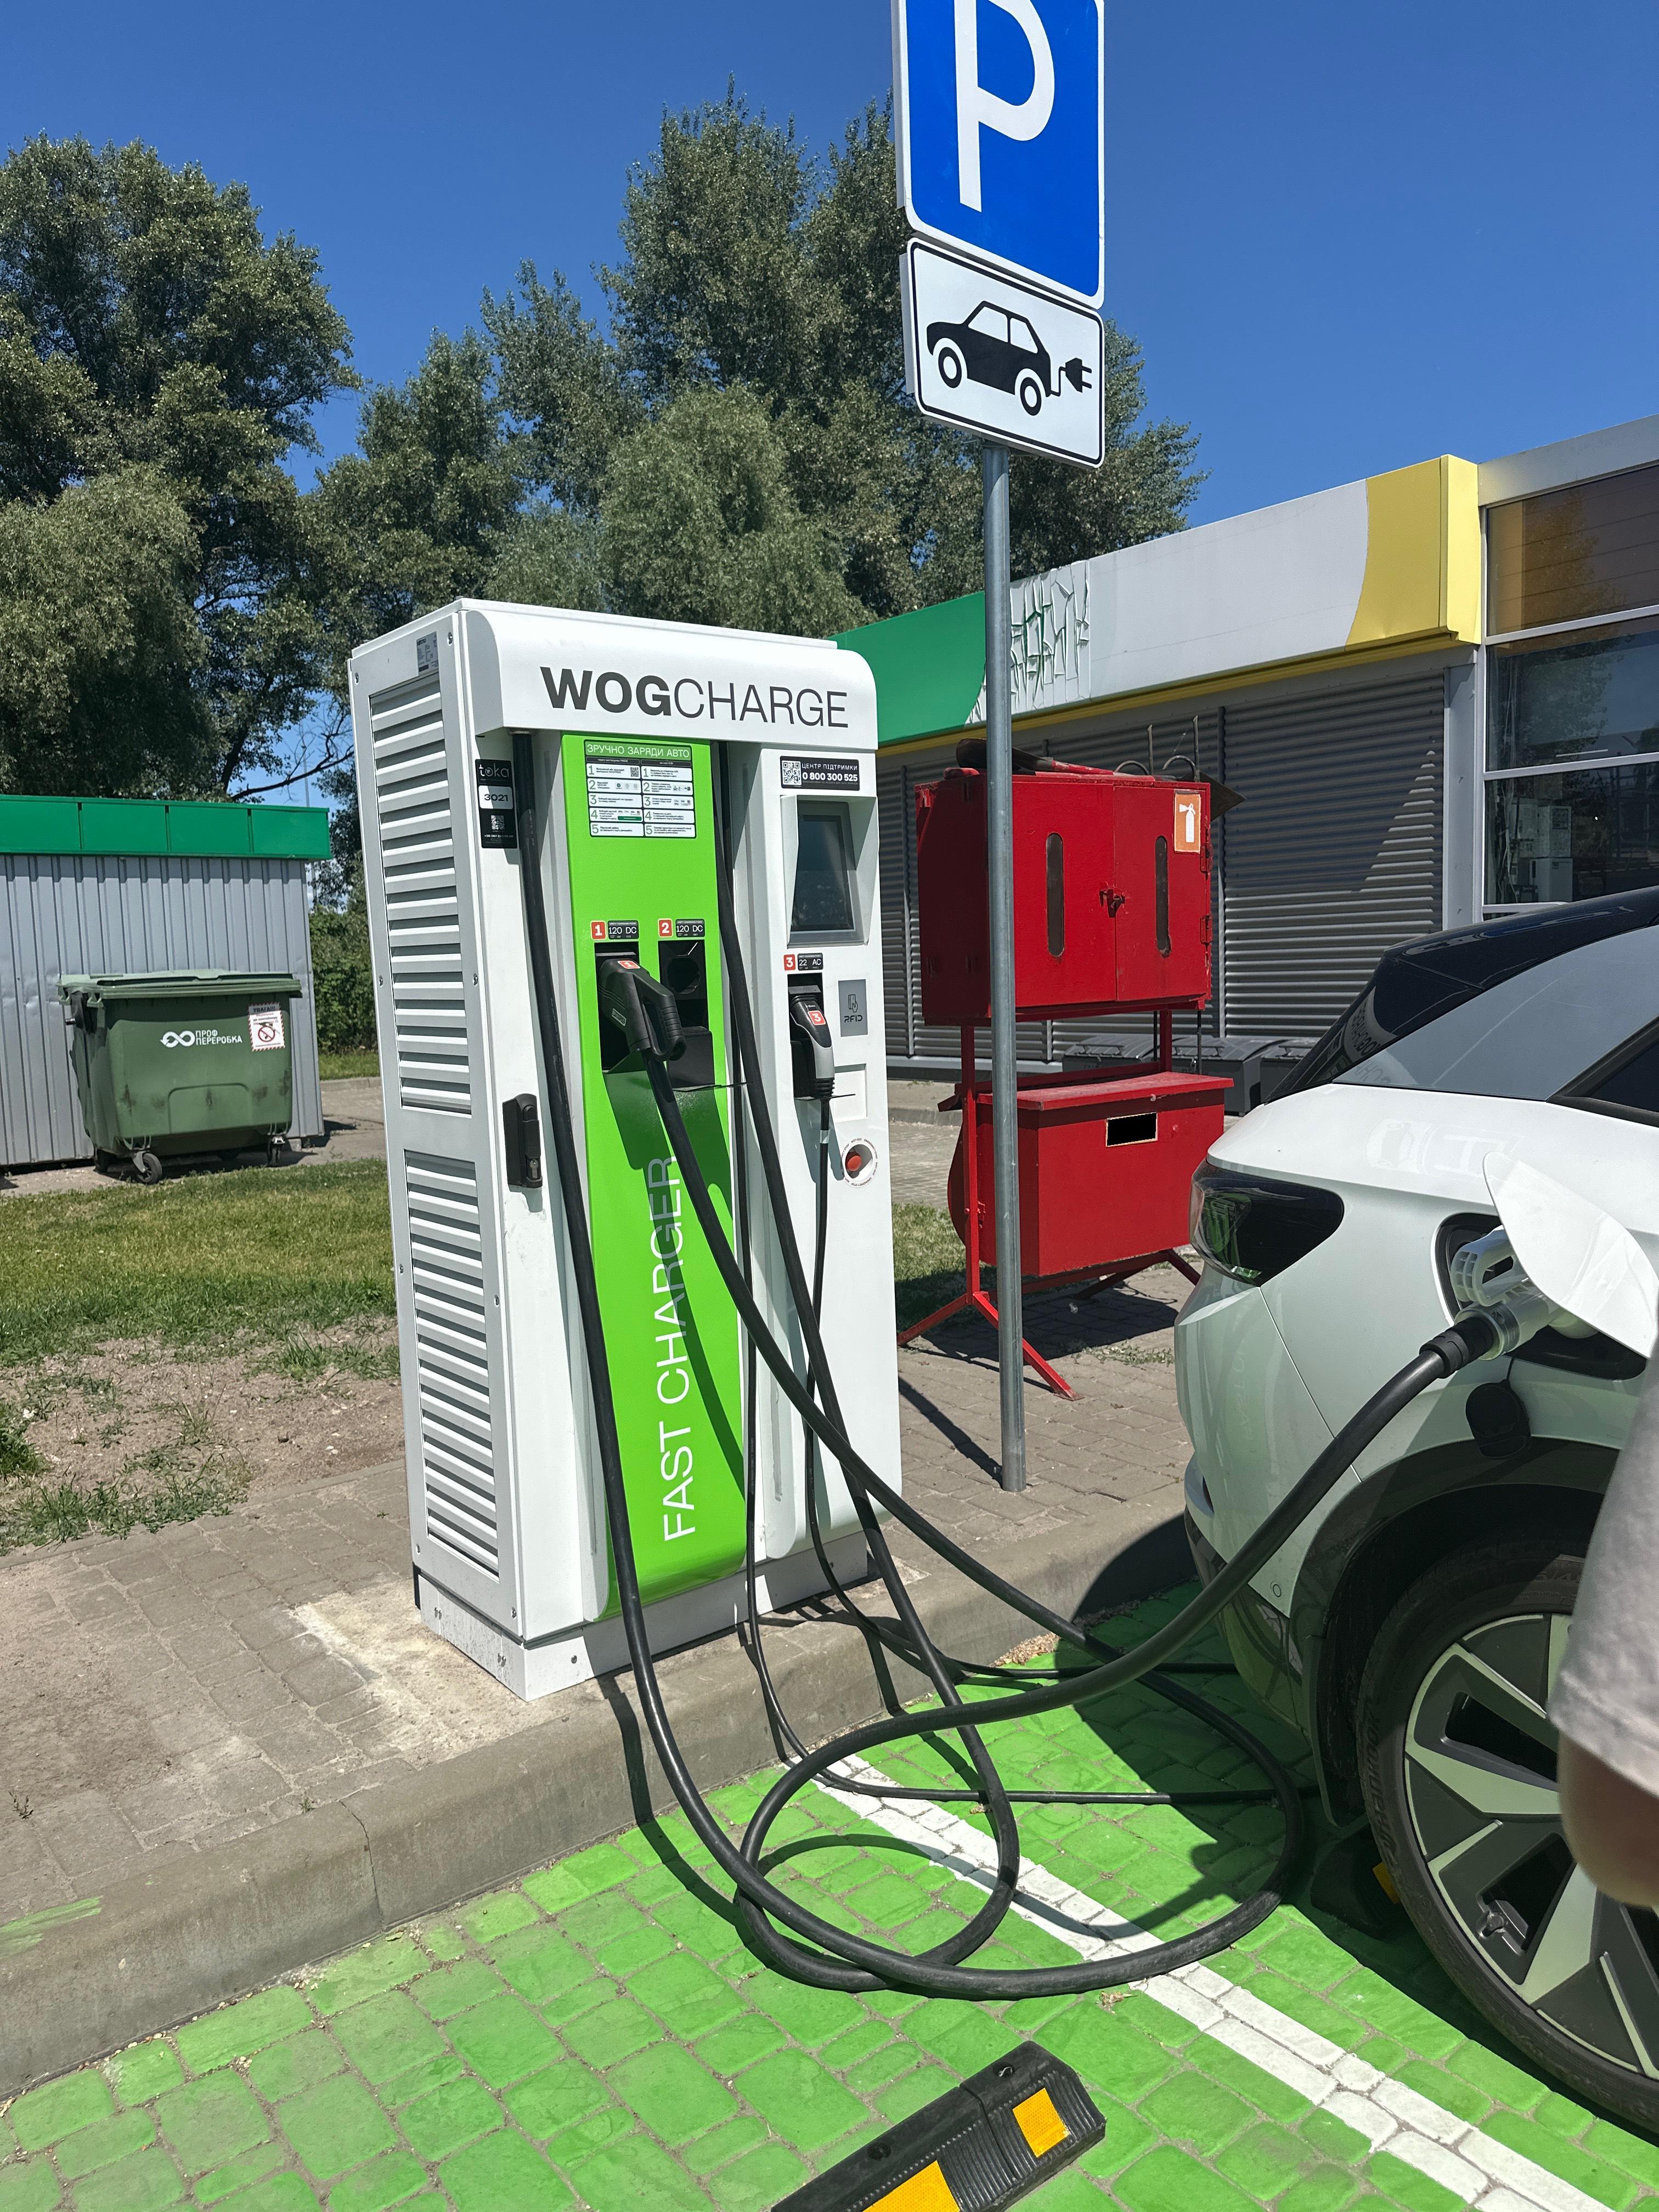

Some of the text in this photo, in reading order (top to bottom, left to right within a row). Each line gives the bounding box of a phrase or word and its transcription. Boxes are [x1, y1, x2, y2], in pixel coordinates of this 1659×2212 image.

[954, 0, 1055, 213] P
[539, 665, 849, 729] WOGCHARGE
[587, 744, 690, 758] ЗРУЧНО ЗАРЯДИ АВТО
[478, 763, 510, 777] toka
[844, 774, 858, 782] 525
[595, 924, 603, 936] 1
[661, 922, 670, 934] 2
[786, 957, 794, 968] 3
[812, 1013, 821, 1022] 3
[844, 1014, 863, 1023] RFID
[195, 1029, 218, 1037] ПРОФ
[196, 1035, 242, 1045] ПЕРЕРОБКА
[648, 1156, 690, 1404] CHARGER
[659, 1420, 696, 1541] FAST
